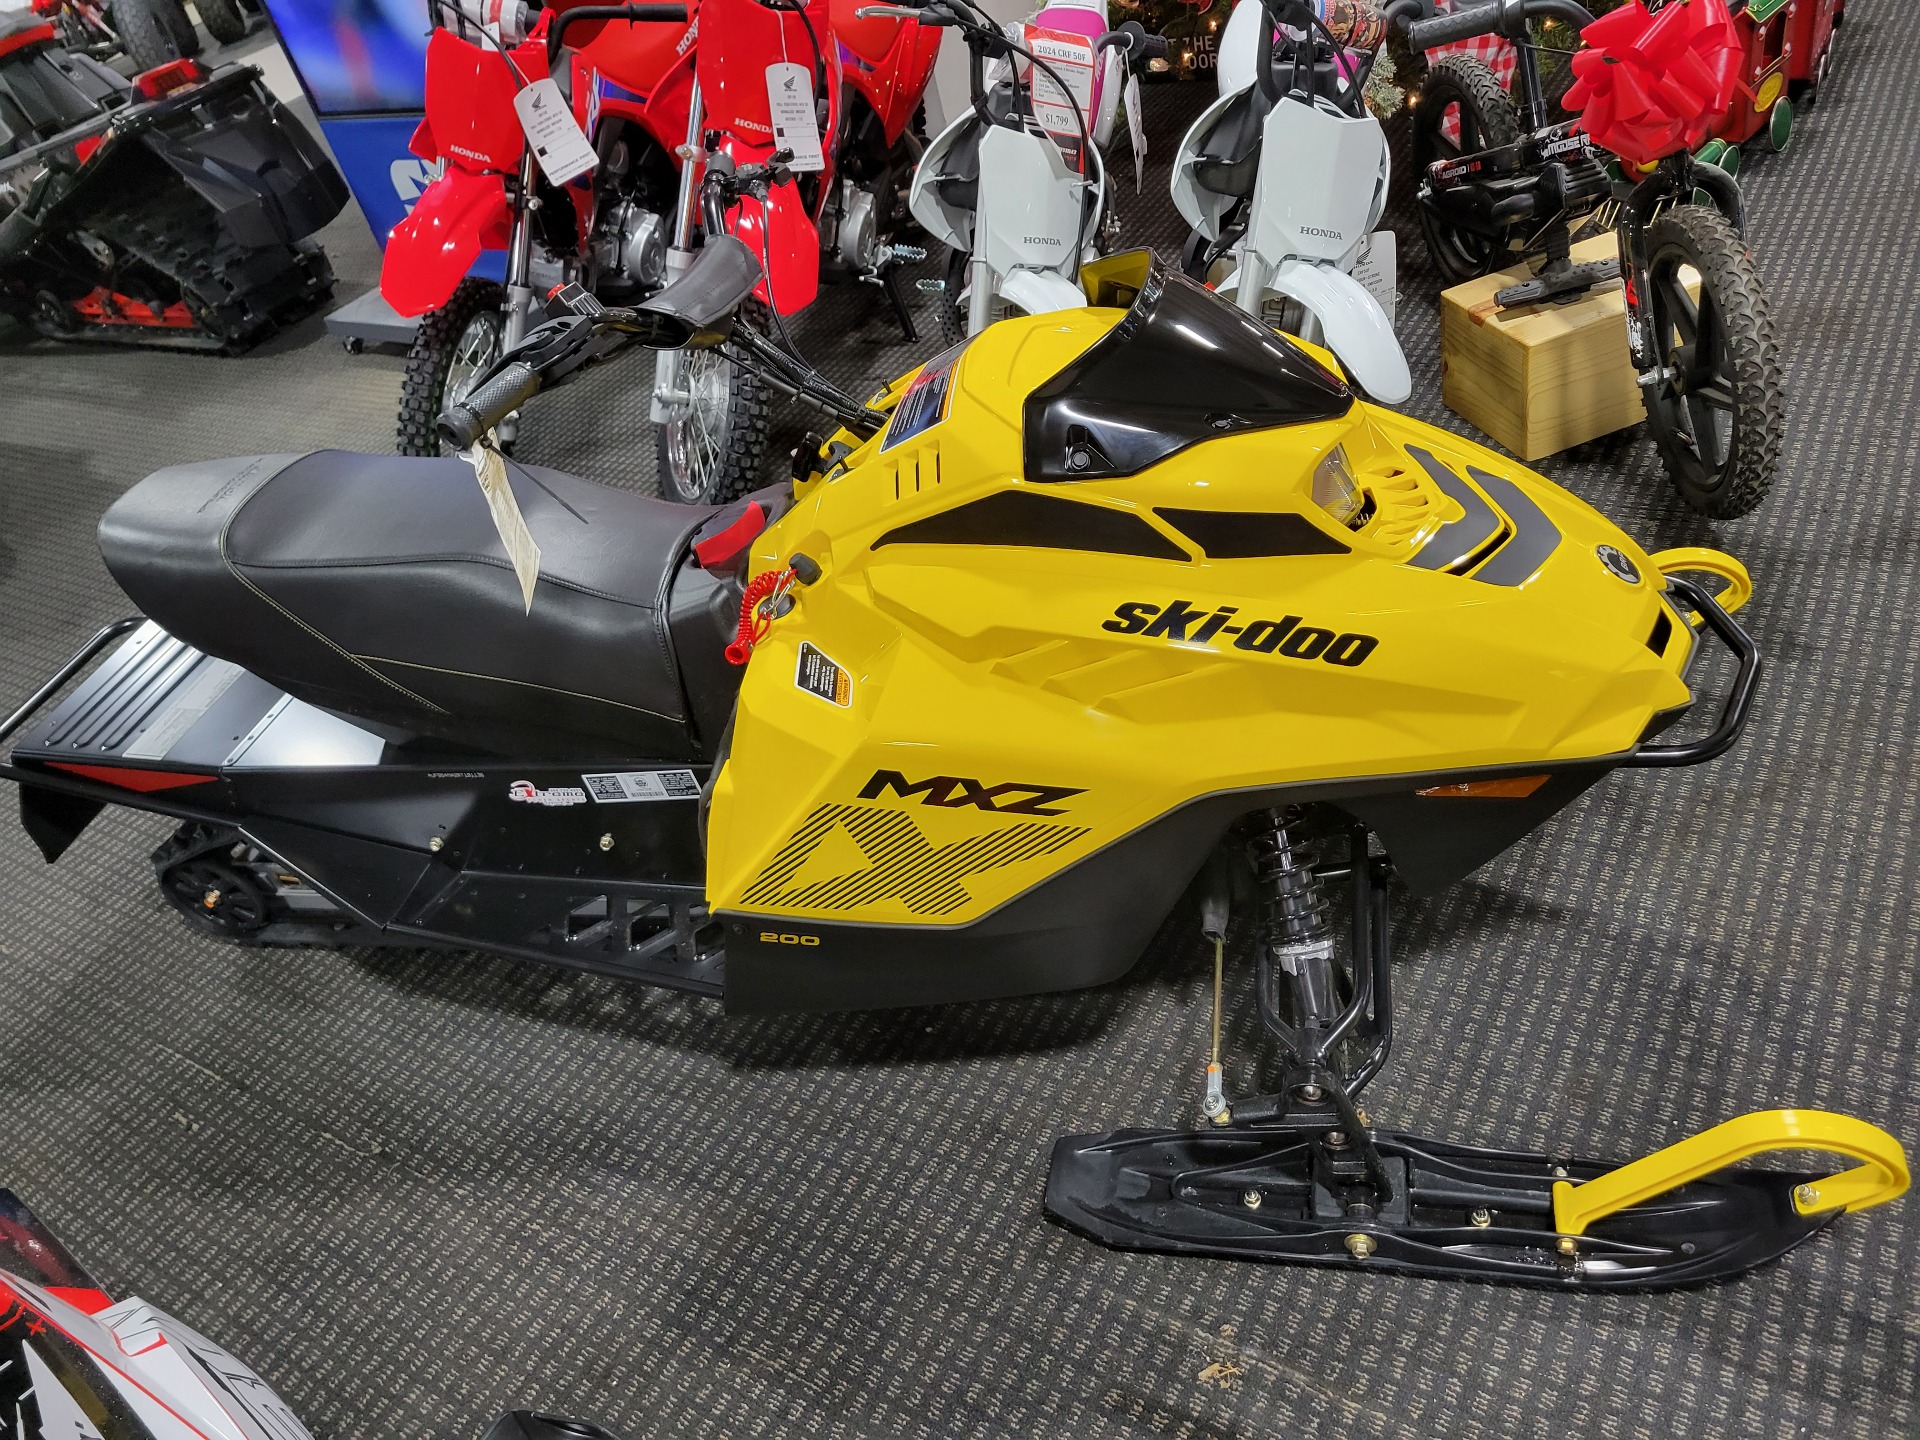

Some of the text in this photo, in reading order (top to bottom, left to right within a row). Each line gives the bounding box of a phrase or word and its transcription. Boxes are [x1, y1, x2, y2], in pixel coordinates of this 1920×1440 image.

[1183, 35, 1215, 52] THE
[1038, 45, 1086, 61] 2024 CRF 50F
[1045, 113, 1069, 126] $1,799
[450, 144, 491, 163] HONDA
[1548, 135, 1581, 156] MOOSE
[1300, 225, 1343, 240] HONDA
[1023, 236, 1061, 246] HONDA
[1101, 600, 1379, 667] ski-doo
[856, 769, 1092, 816] MXZ
[759, 932, 820, 946] 200
